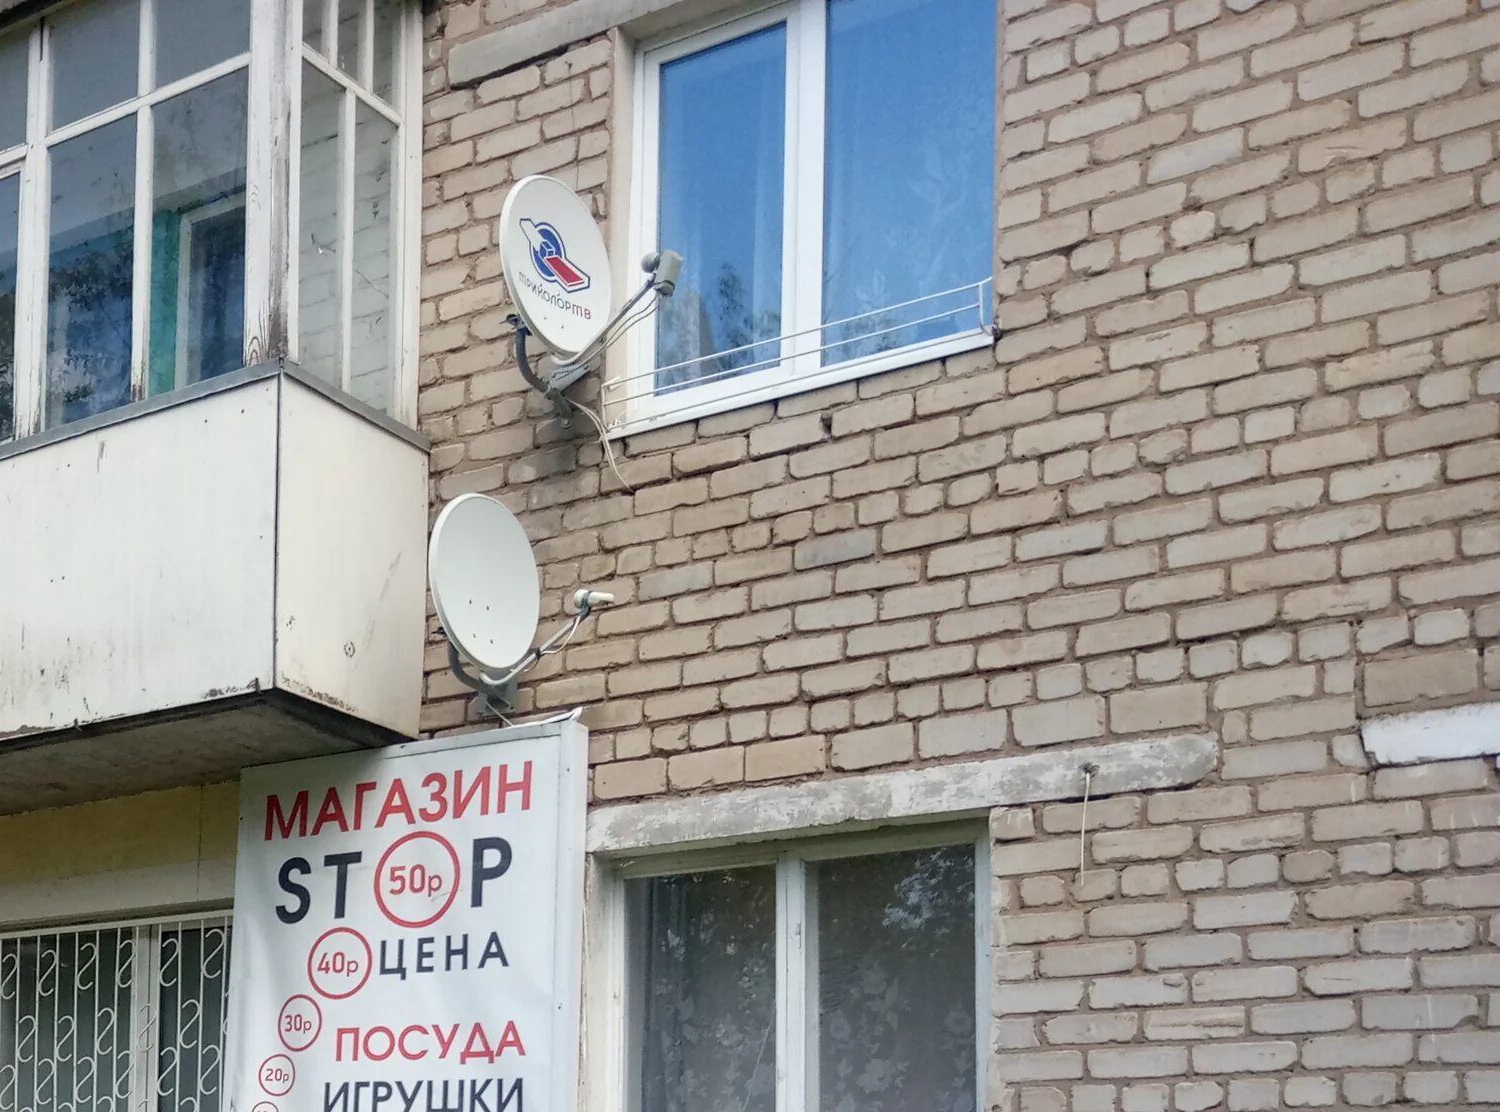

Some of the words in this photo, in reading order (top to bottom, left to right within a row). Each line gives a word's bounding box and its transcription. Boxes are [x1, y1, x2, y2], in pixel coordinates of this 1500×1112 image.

[264, 760, 533, 841] МАГАЗИН
[389, 864, 443, 897] 50р
[317, 951, 359, 978] 40р
[379, 931, 510, 980] ЦЕНА
[284, 1014, 312, 1034] 30р
[335, 1020, 526, 1065] ПОСУДА
[264, 1068, 290, 1084] 20р
